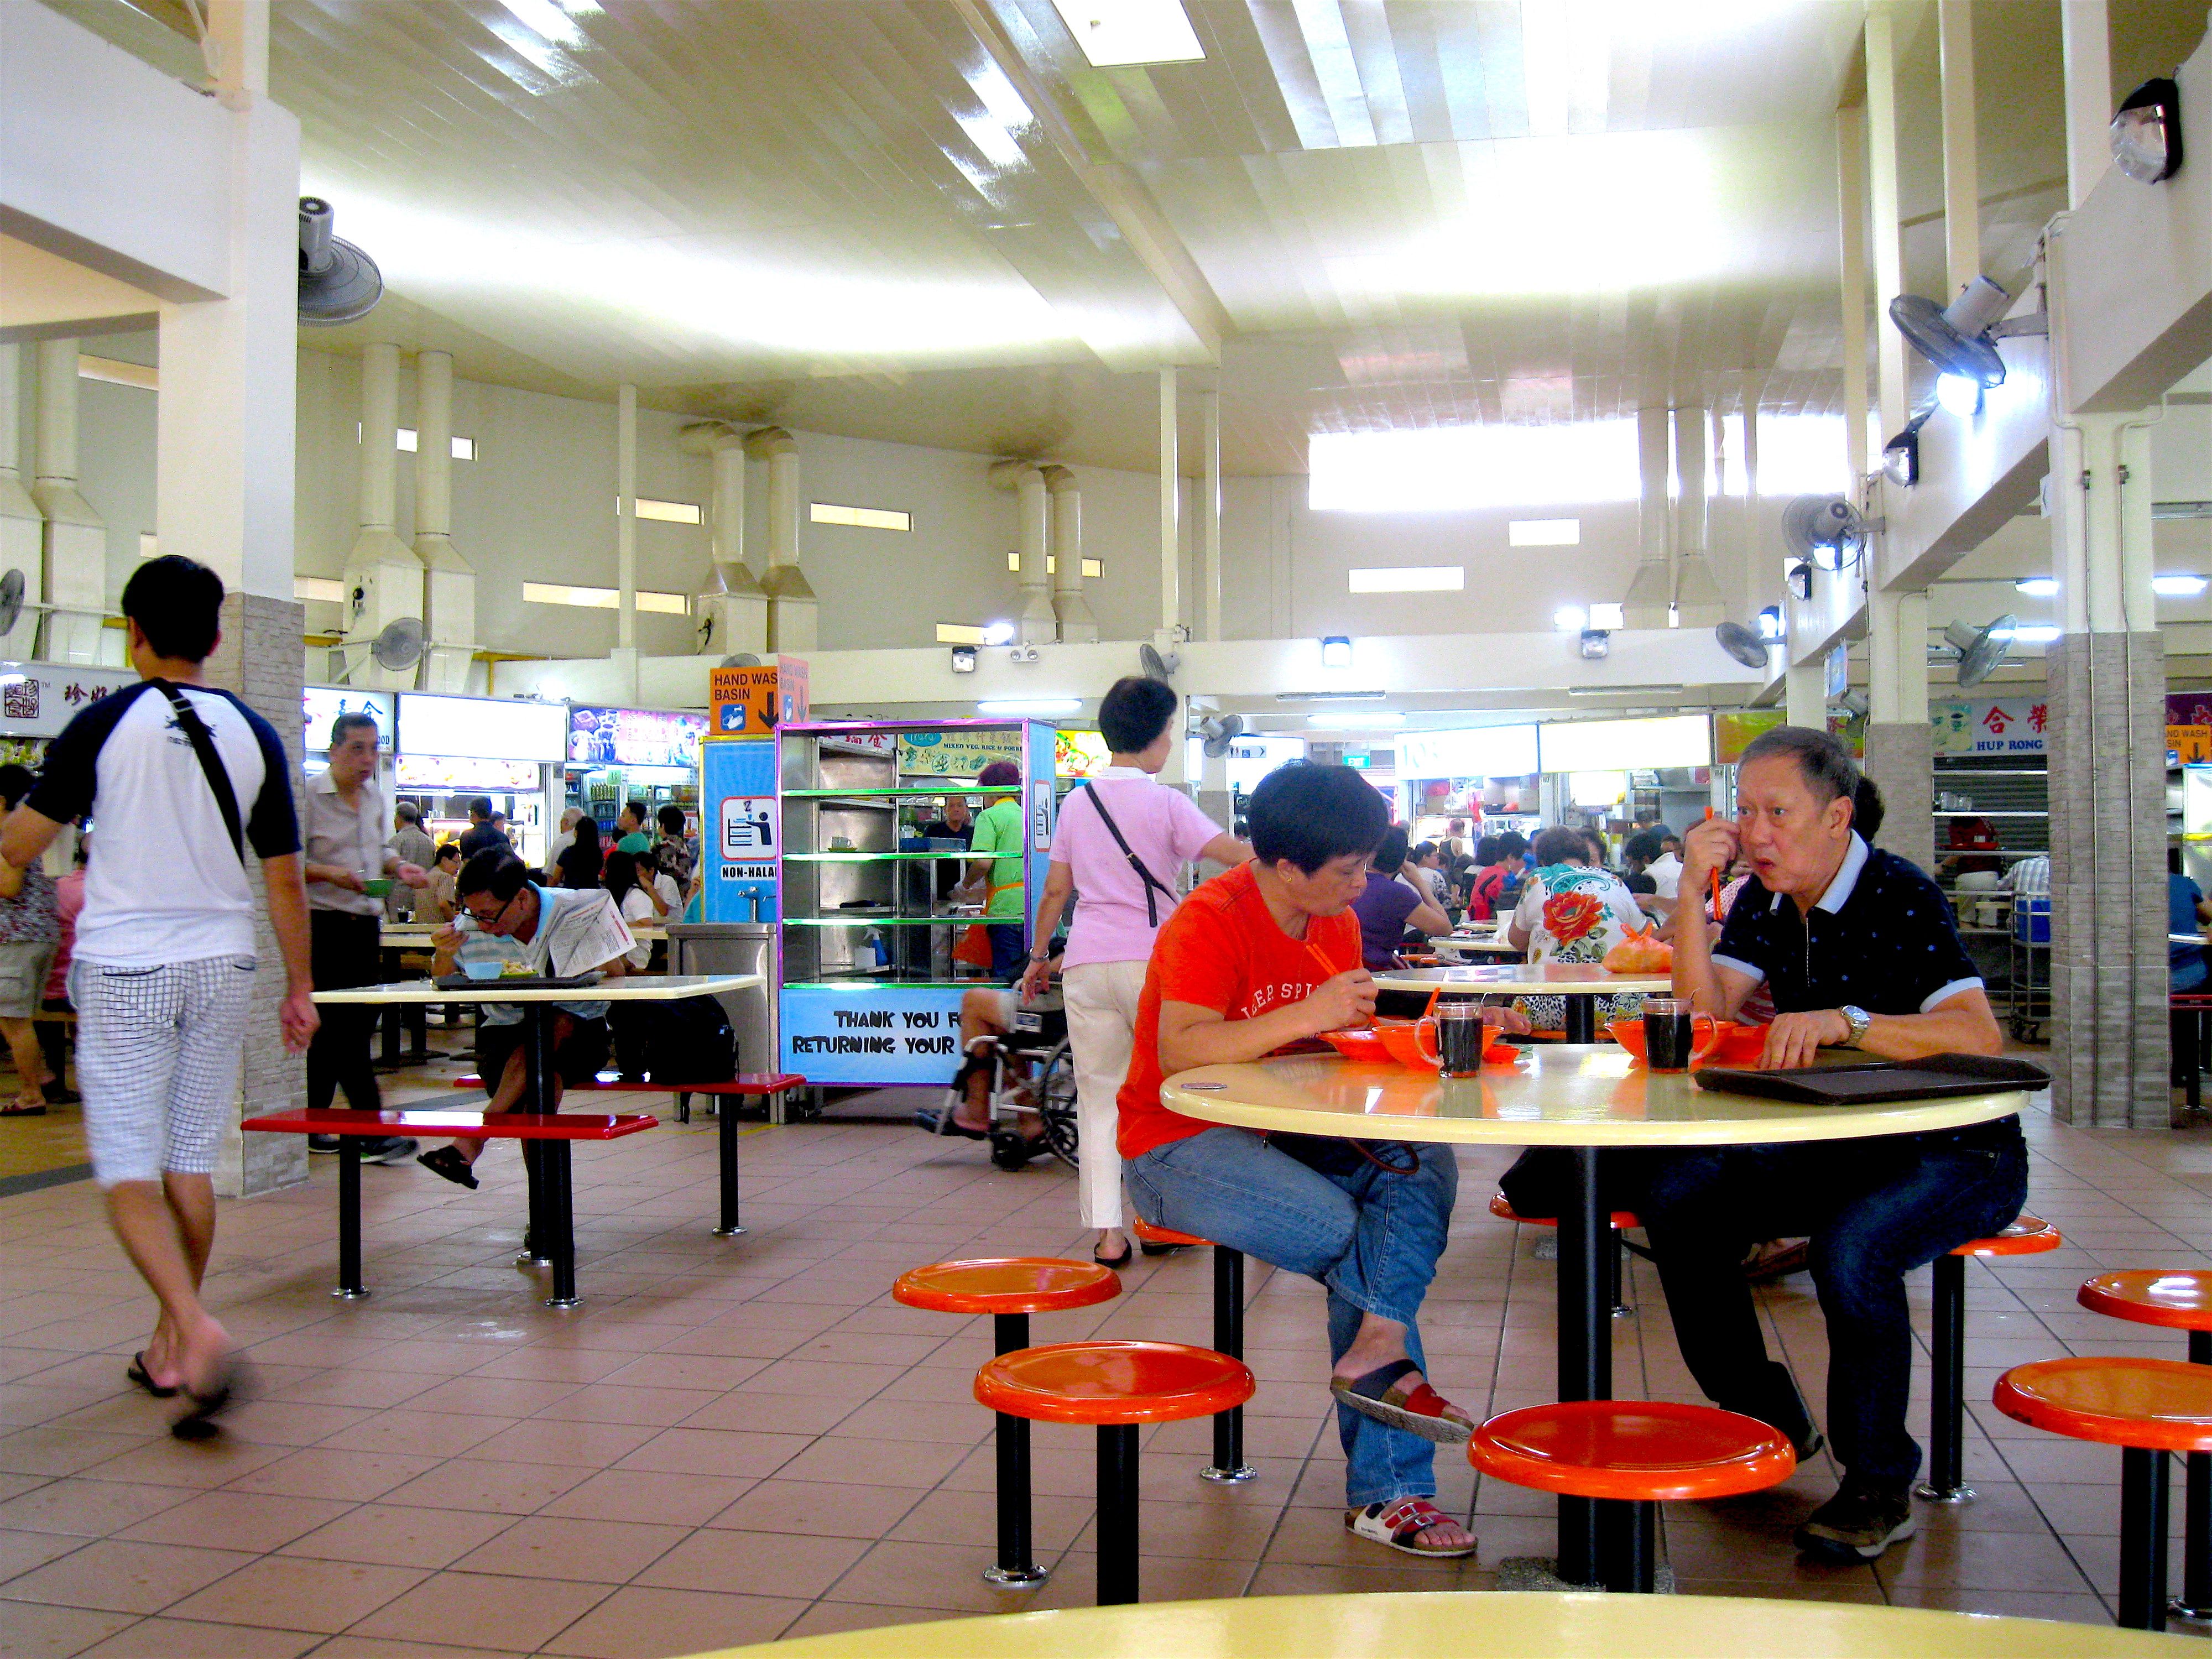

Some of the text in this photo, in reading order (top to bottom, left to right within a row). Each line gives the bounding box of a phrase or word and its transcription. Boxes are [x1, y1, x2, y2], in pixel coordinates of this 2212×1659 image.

[714, 673, 778, 686] HAND WAS
[714, 688, 750, 701] BASIN
[2180, 729, 2208, 738] WASH
[1976, 739, 2043, 751] HUP RONG
[1348, 757, 1364, 766] EXIT
[1281, 983, 1320, 999] SPI
[833, 1010, 961, 1029] THANK YOU F
[792, 1035, 955, 1055] RETURNING YOUR
